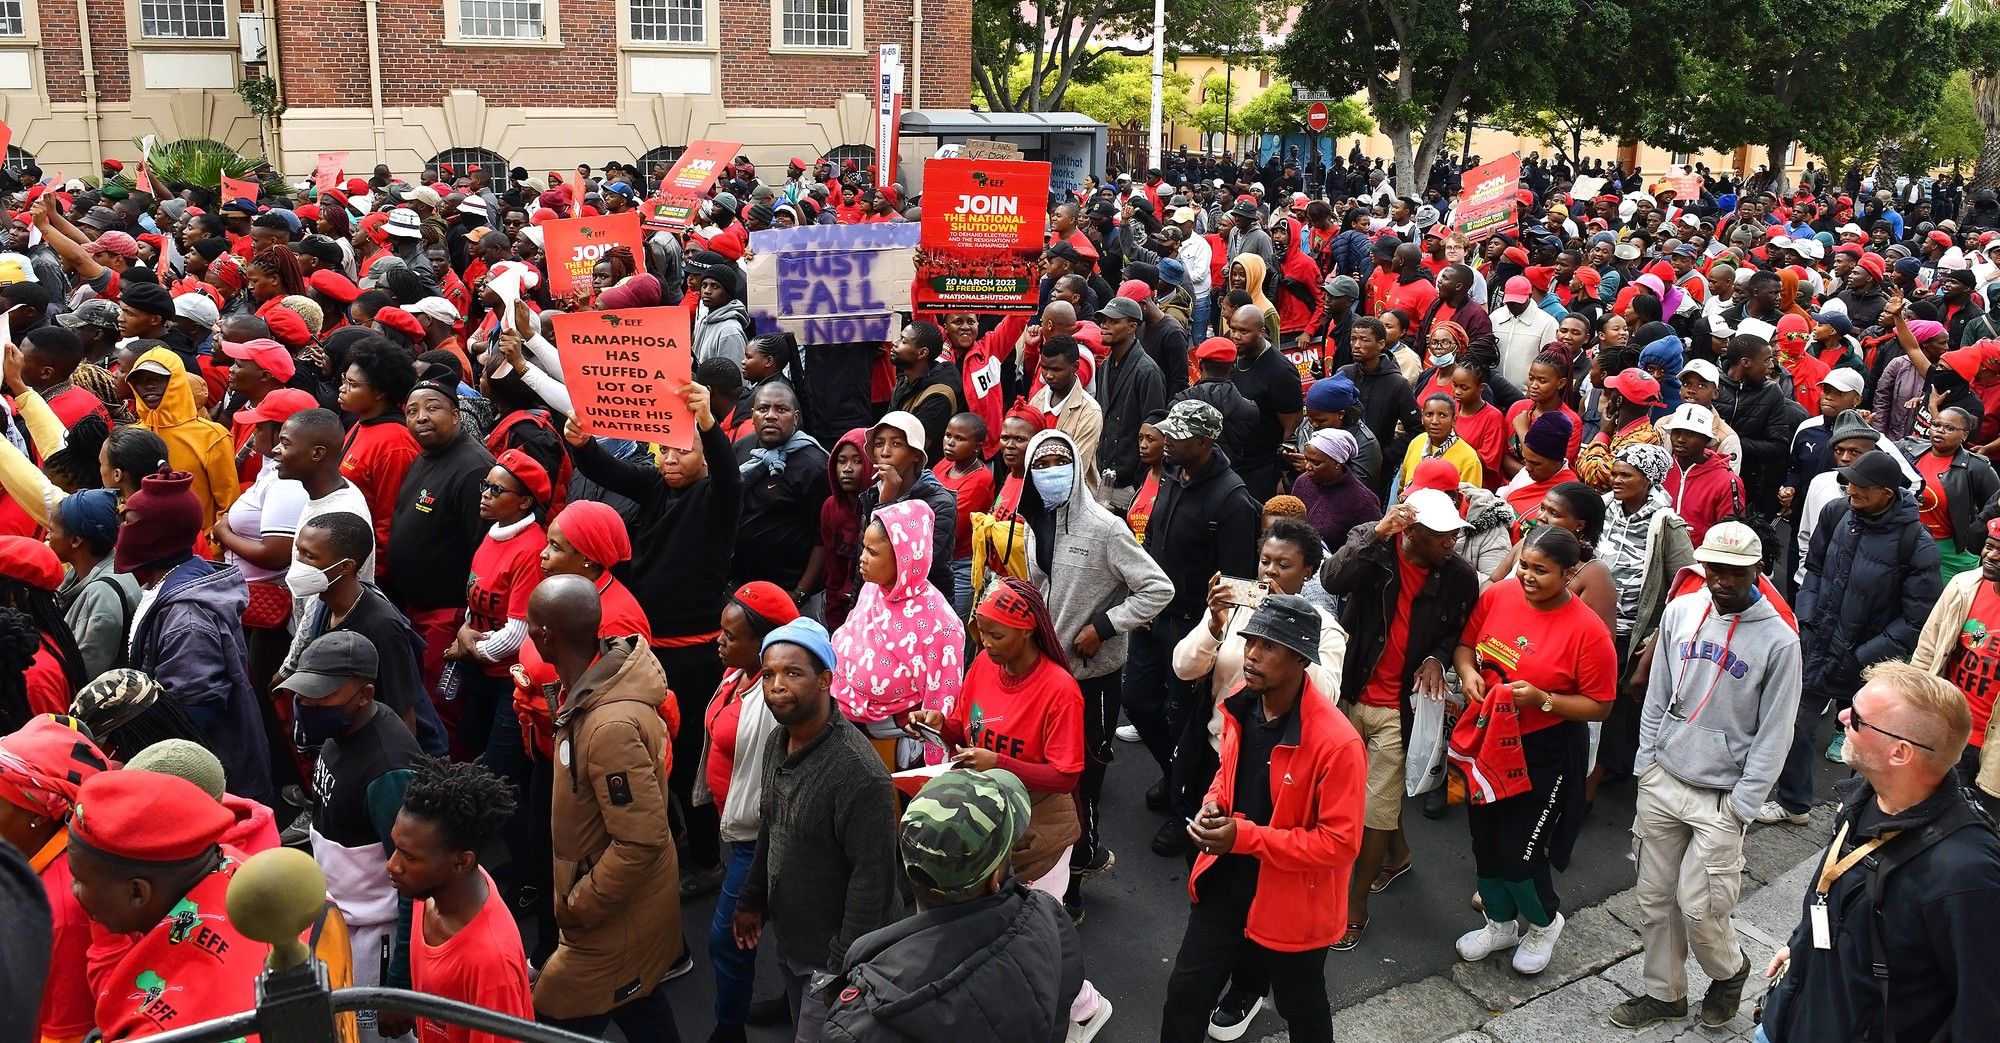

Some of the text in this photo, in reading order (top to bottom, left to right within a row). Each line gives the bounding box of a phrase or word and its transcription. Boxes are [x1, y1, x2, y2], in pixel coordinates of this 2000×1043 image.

[1052, 154, 1083, 168] wifi that
[1052, 168, 1075, 179] works
[989, 179, 1005, 187] EFF
[1052, 180, 1078, 191] out the
[1475, 174, 1505, 194] JOIN
[954, 194, 1018, 215] JOIN
[944, 213, 1026, 224] THE NATIONAL
[950, 223, 1018, 232] SHUTDOWN
[564, 261, 582, 270] THE
[777, 251, 879, 278] MUST
[945, 278, 957, 286] 20
[779, 279, 885, 316] FALL
[624, 319, 644, 327] EFF
[805, 315, 892, 345] NOW
[571, 334, 677, 348] RAMAPHOSA
[606, 351, 640, 362] HAS
[582, 365, 666, 380] STUFFED A
[597, 382, 653, 394] LOT OF
[596, 396, 657, 407] MONEY
[586, 407, 673, 420] UNDER HIS
[592, 420, 671, 434] MATTRESS
[473, 586, 505, 610] EFF
[1490, 637, 1521, 660] PROVINCIAL
[1955, 665, 1992, 698] EFF
[984, 728, 1025, 759] EFF
[1531, 809, 1550, 840] URBAN
[1522, 841, 1535, 861] LIFE
[195, 927, 229, 955] EFF
[148, 1000, 178, 1023] EFF
